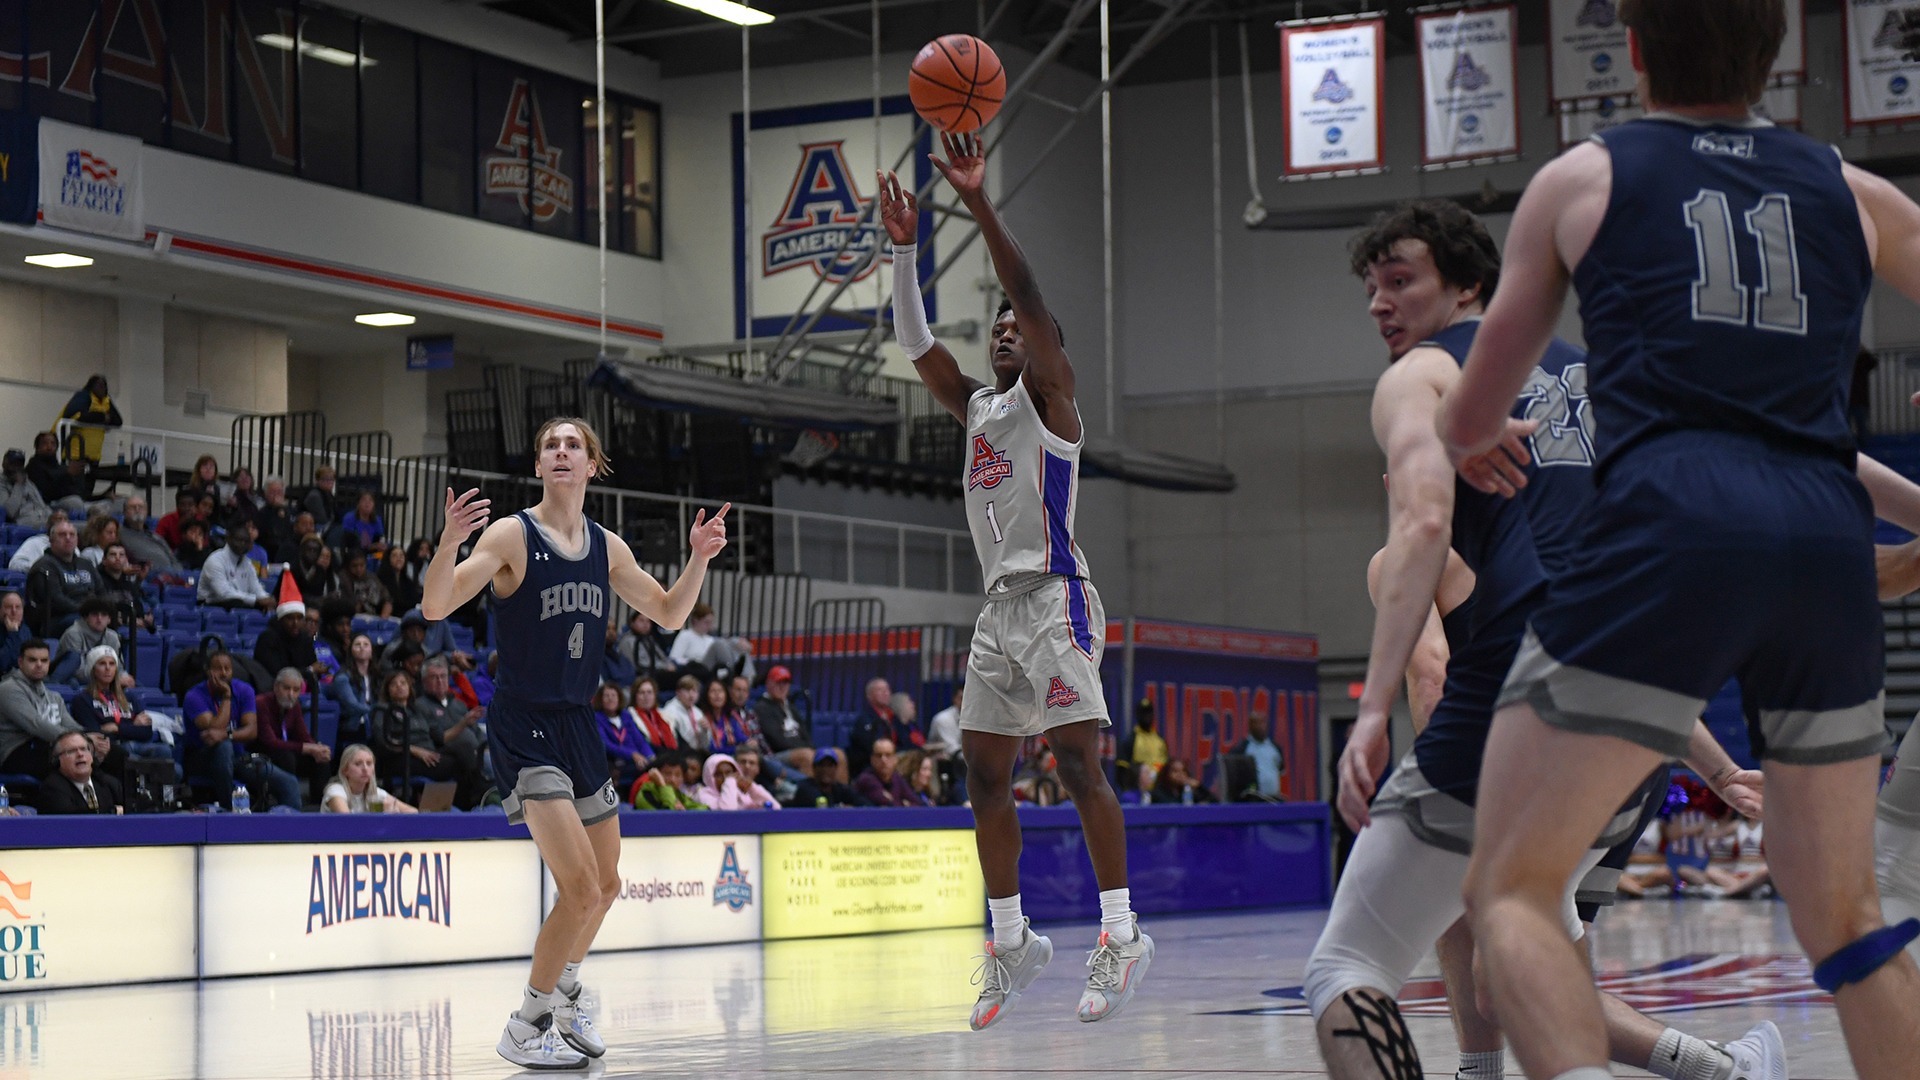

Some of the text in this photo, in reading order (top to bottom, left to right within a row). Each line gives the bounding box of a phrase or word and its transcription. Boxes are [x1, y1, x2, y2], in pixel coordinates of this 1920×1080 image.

[773, 229, 894, 263] AMERICA
[1682, 187, 1808, 335] 11
[970, 465, 1009, 486] AMERICAN
[986, 500, 1003, 544] 1
[540, 581, 603, 621] HOOD
[568, 622, 584, 659] 4
[306, 851, 451, 936] AMERICAN
[616, 878, 705, 903] Ueagles.com
